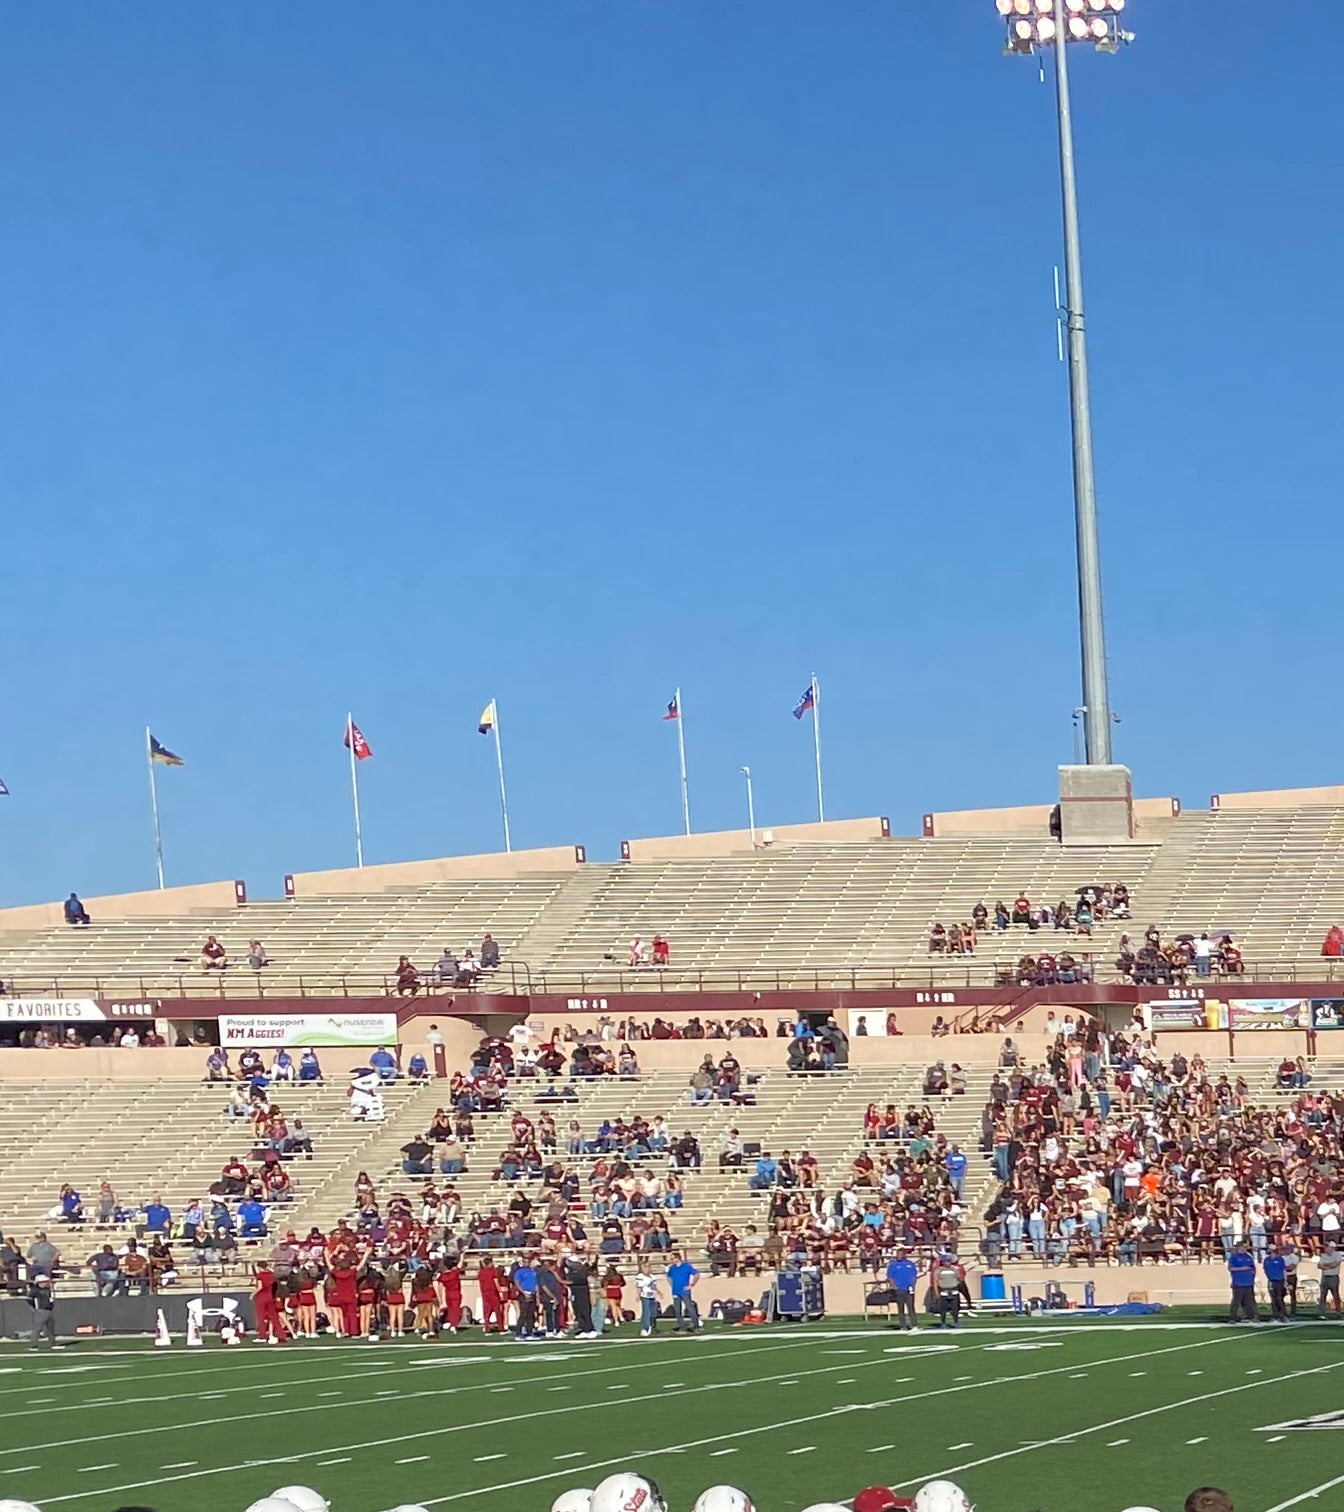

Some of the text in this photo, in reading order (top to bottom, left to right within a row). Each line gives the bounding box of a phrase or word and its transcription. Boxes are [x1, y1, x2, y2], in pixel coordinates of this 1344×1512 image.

[7, 1002, 82, 1017] FAVORITES
[227, 1018, 305, 1028] Proud to support
[227, 1028, 245, 1038] NM
